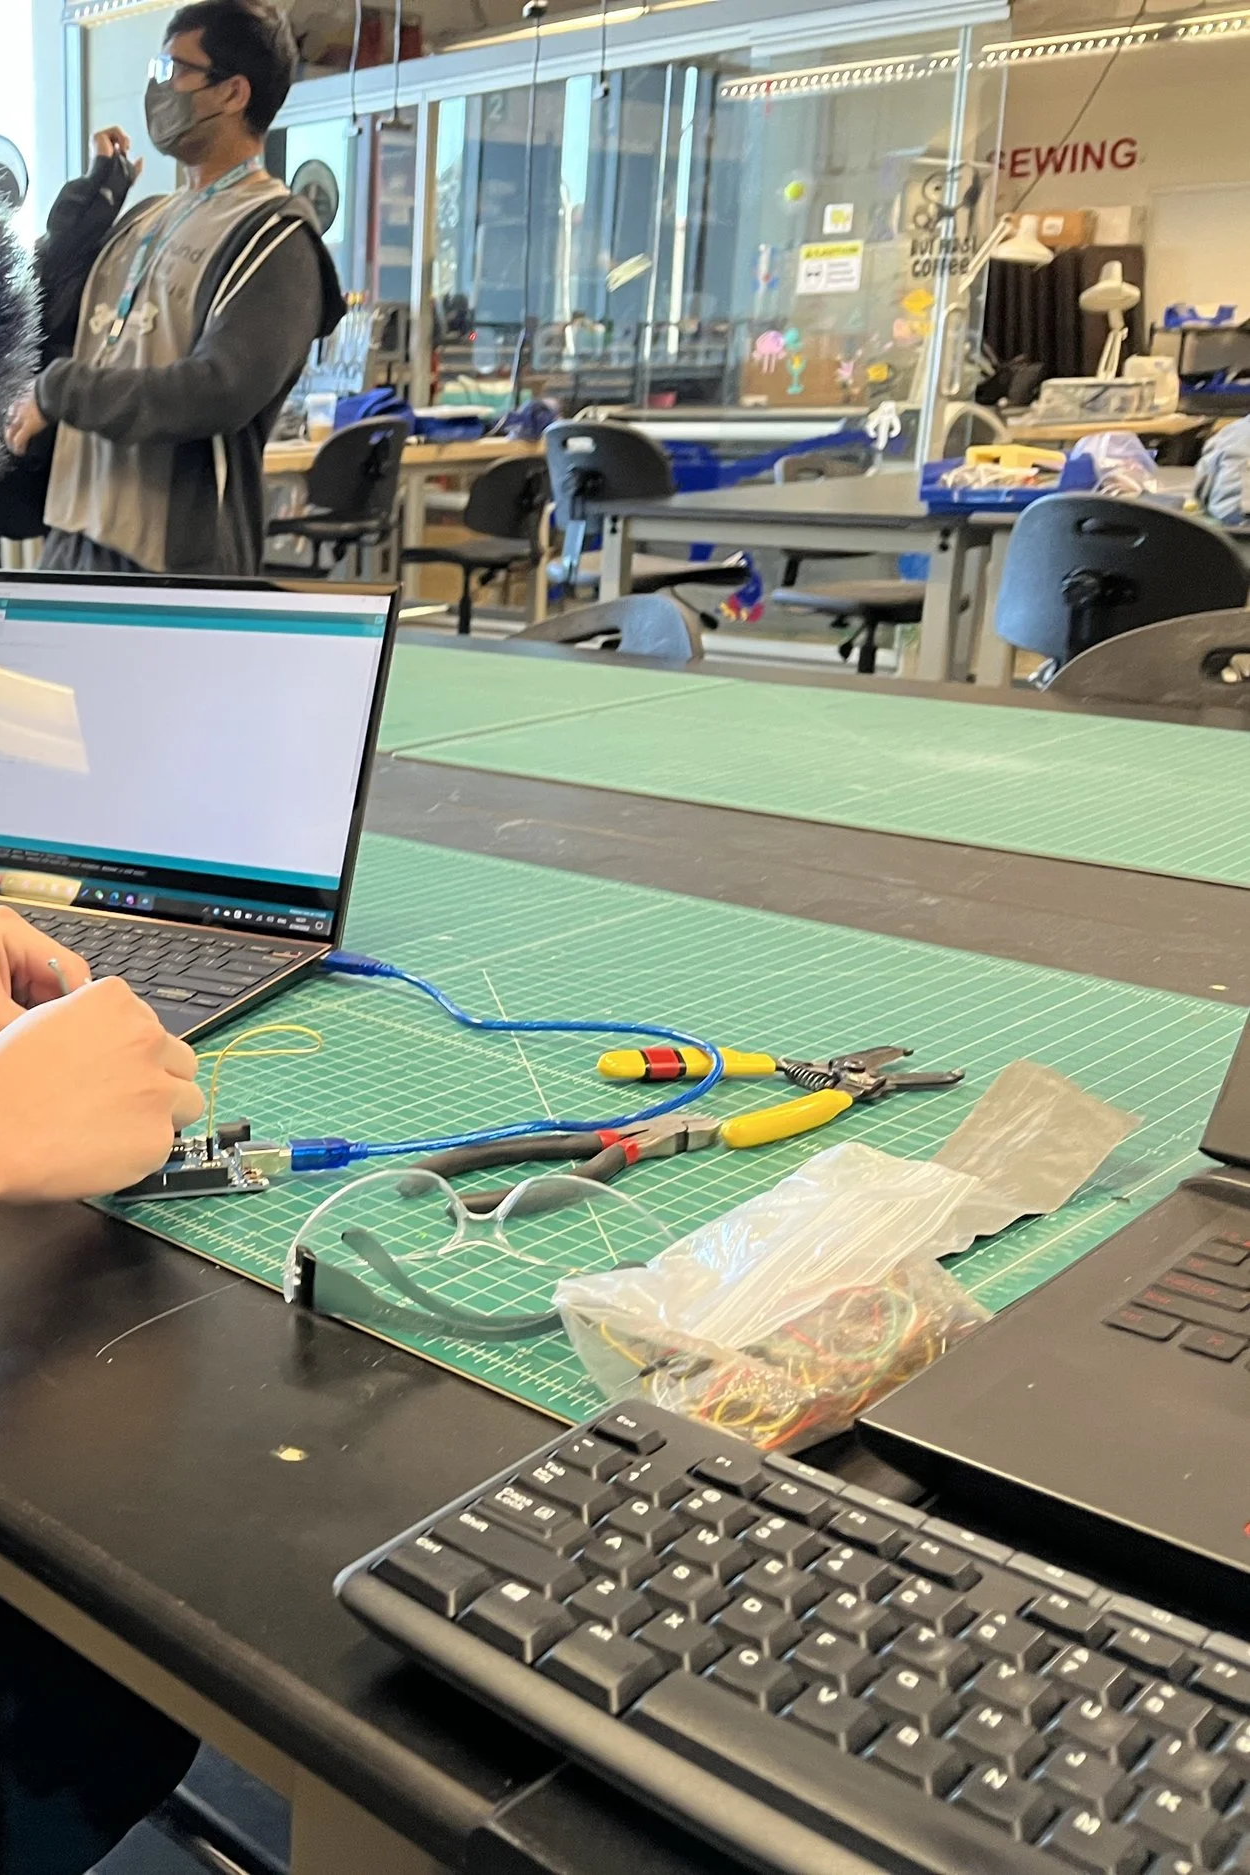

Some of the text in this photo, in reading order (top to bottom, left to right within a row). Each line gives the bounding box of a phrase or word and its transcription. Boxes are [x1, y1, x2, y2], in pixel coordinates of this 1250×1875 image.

[697, 1527, 720, 1545] W
[663, 1613, 685, 1629] X
[998, 1663, 1017, 1679] Y
[818, 1686, 838, 1703] V
[978, 1708, 1003, 1728] H
[1080, 1700, 1103, 1719] U
[1065, 1752, 1087, 1767] J
[983, 1768, 1008, 1790] N
[1156, 1790, 1182, 1813] K
[1073, 1812, 1101, 1835] M
